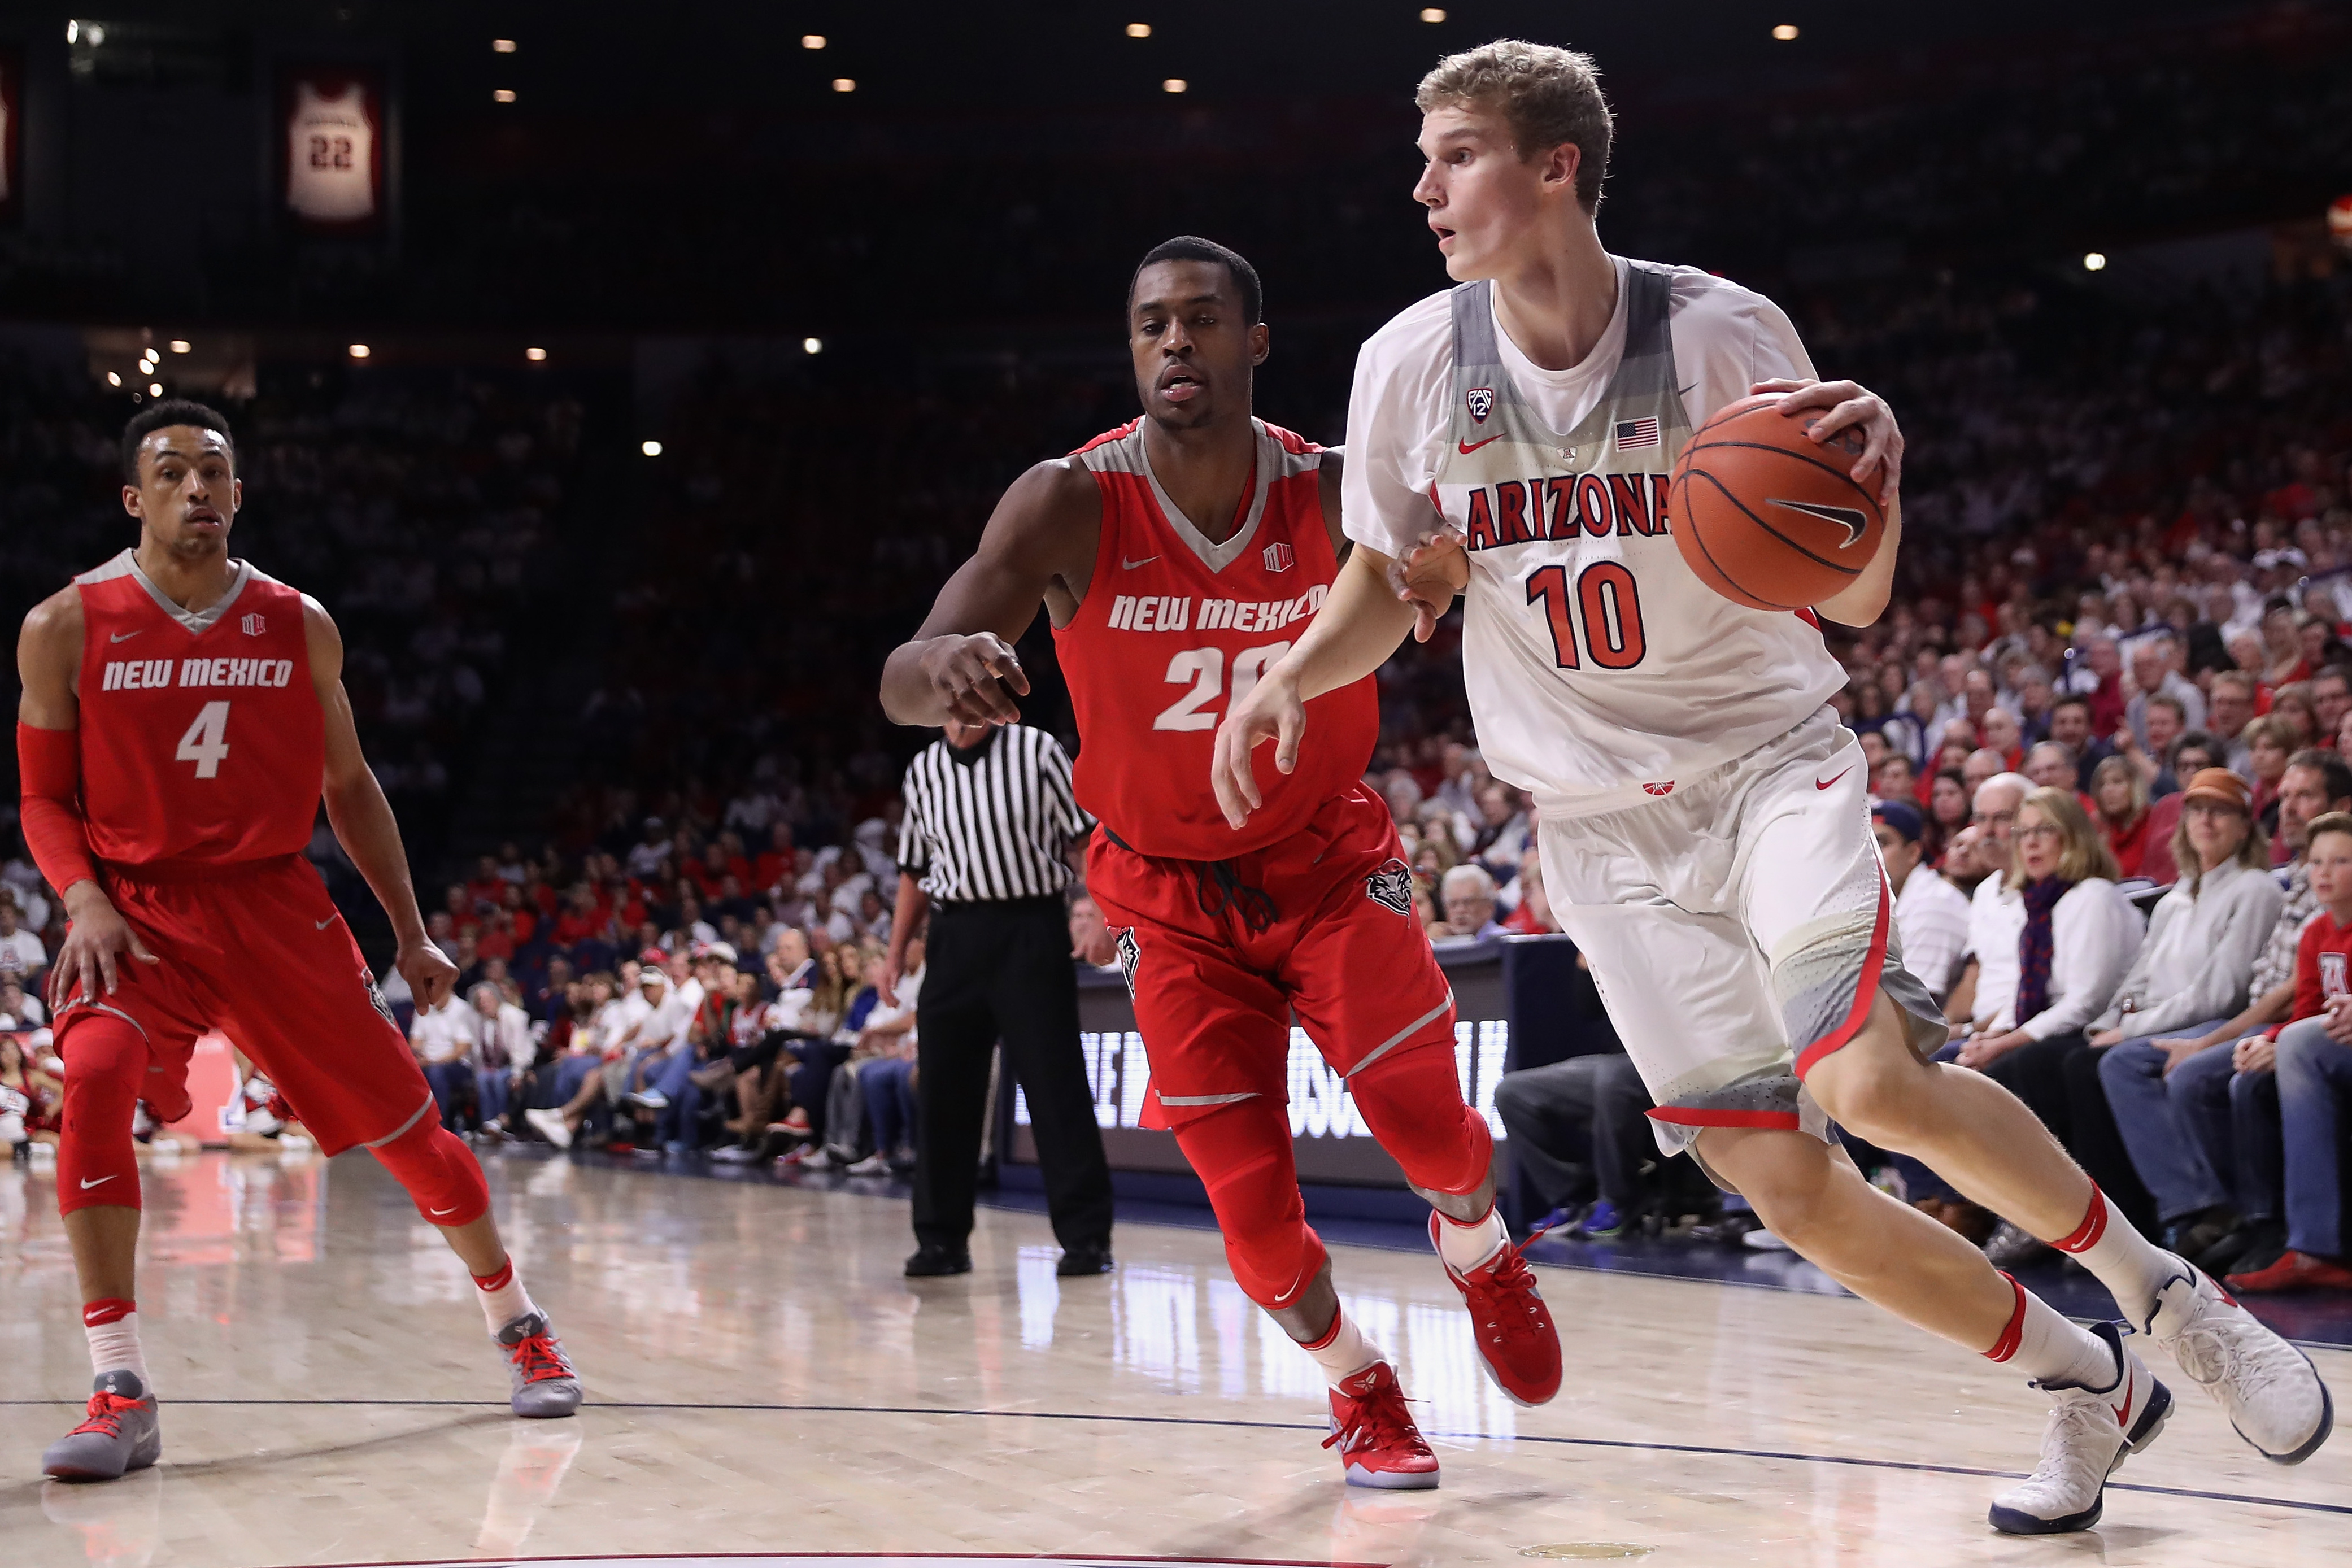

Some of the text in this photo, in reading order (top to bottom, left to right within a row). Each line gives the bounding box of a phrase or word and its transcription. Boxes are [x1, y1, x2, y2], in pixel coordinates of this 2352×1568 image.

[309, 135, 352, 171] 22
[1468, 390, 1492, 410] PAC
[1473, 403, 1486, 416] 12
[1467, 473, 1673, 551] ARIZONA
[1108, 583, 1330, 632] NEW MEXICO
[1526, 560, 1646, 670] 10
[102, 657, 293, 691] NEW MEXICO
[175, 700, 231, 779] 4
